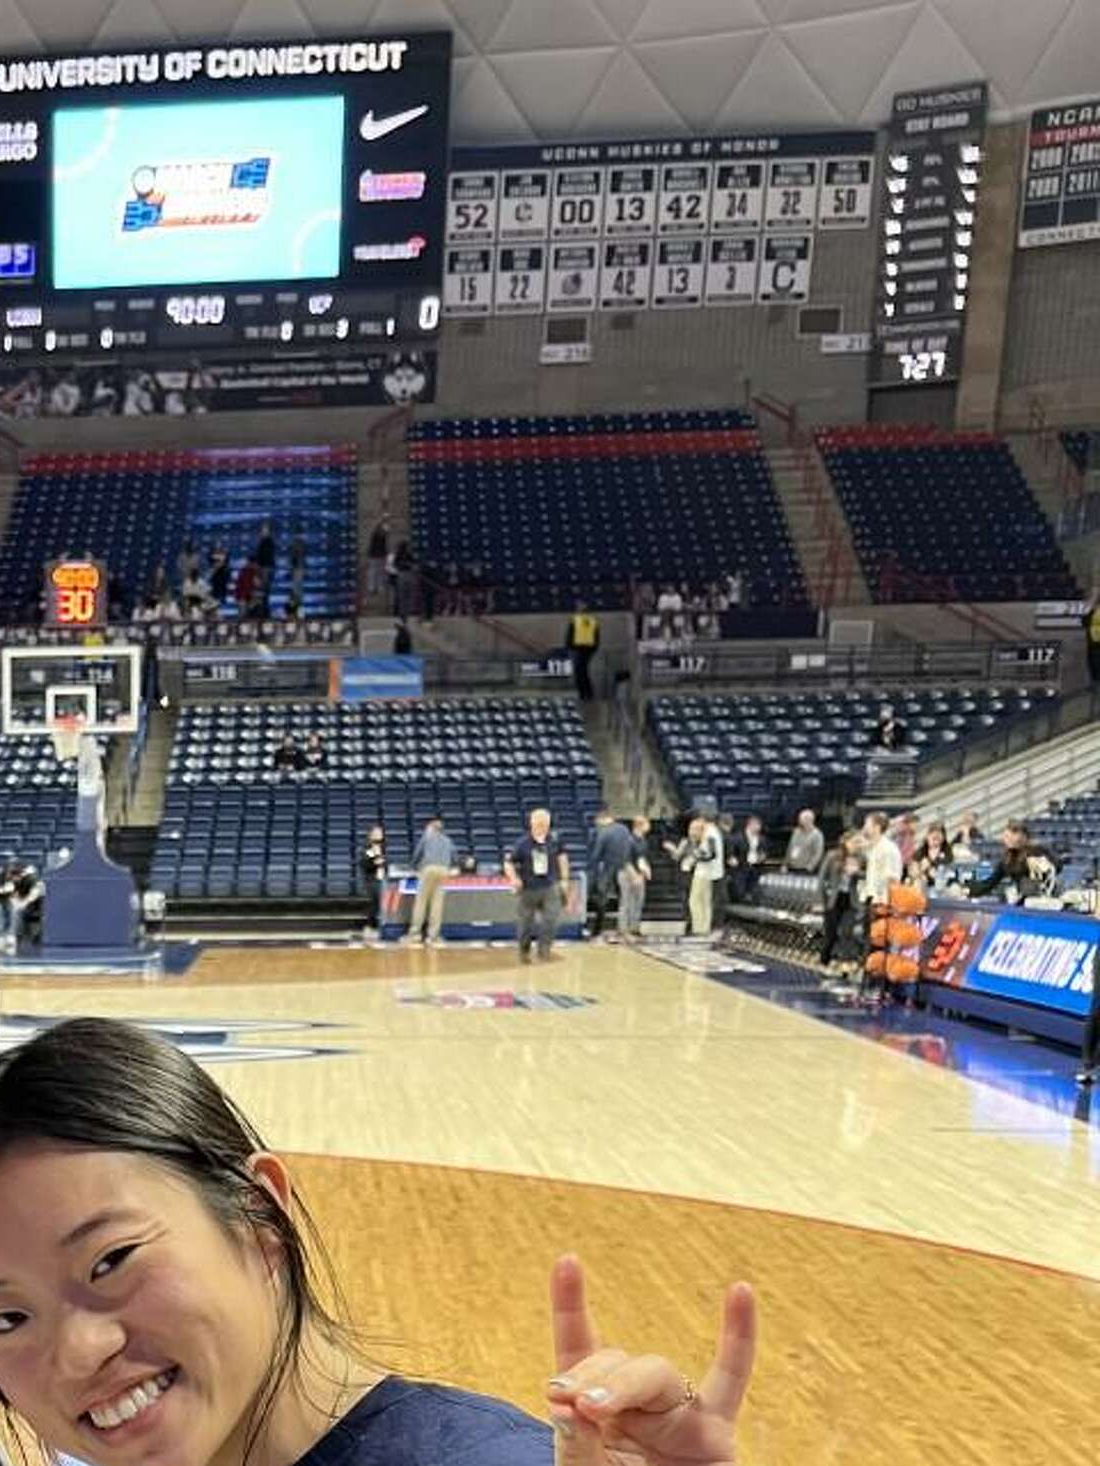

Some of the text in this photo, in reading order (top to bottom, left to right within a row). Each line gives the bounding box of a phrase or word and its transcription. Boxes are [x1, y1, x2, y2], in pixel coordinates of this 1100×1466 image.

[164, 51, 203, 81] OF
[207, 41, 408, 79] CONNECTICUT
[454, 204, 489, 229] 52
[561, 200, 594, 224] 00
[616, 199, 645, 222] 13
[666, 195, 702, 220] 42
[667, 267, 689, 294] 13
[771, 261, 796, 292] C
[419, 296, 441, 330] 0
[57, 590, 94, 622] 30
